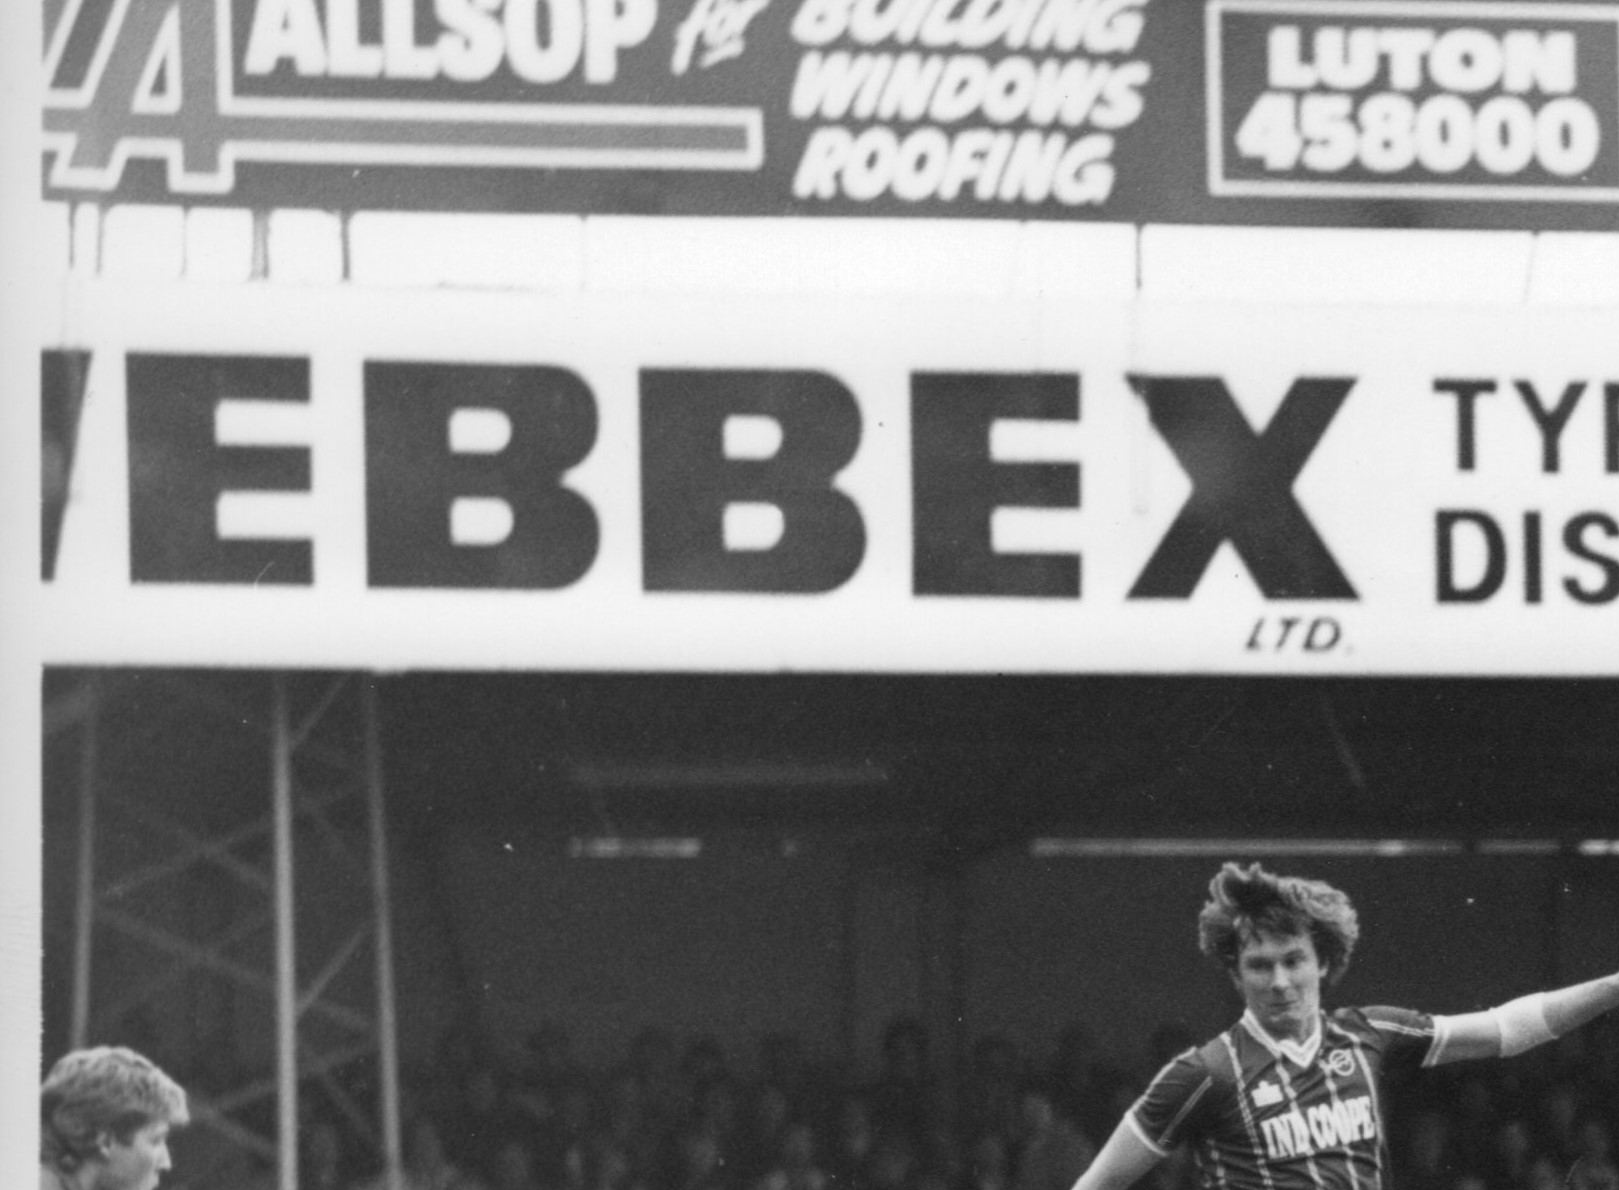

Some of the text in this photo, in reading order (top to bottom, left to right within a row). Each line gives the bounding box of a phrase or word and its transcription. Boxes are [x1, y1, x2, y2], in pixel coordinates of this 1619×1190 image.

[244, 0, 658, 84] ALLSOP
[790, 0, 1148, 53] BUILDING
[1267, 25, 1577, 94] LUTON
[790, 50, 1151, 129] WINDOWS
[792, 124, 1125, 206] ROOFING
[1235, 91, 1600, 175] 458000
[41, 348, 1361, 602] EBBEX
